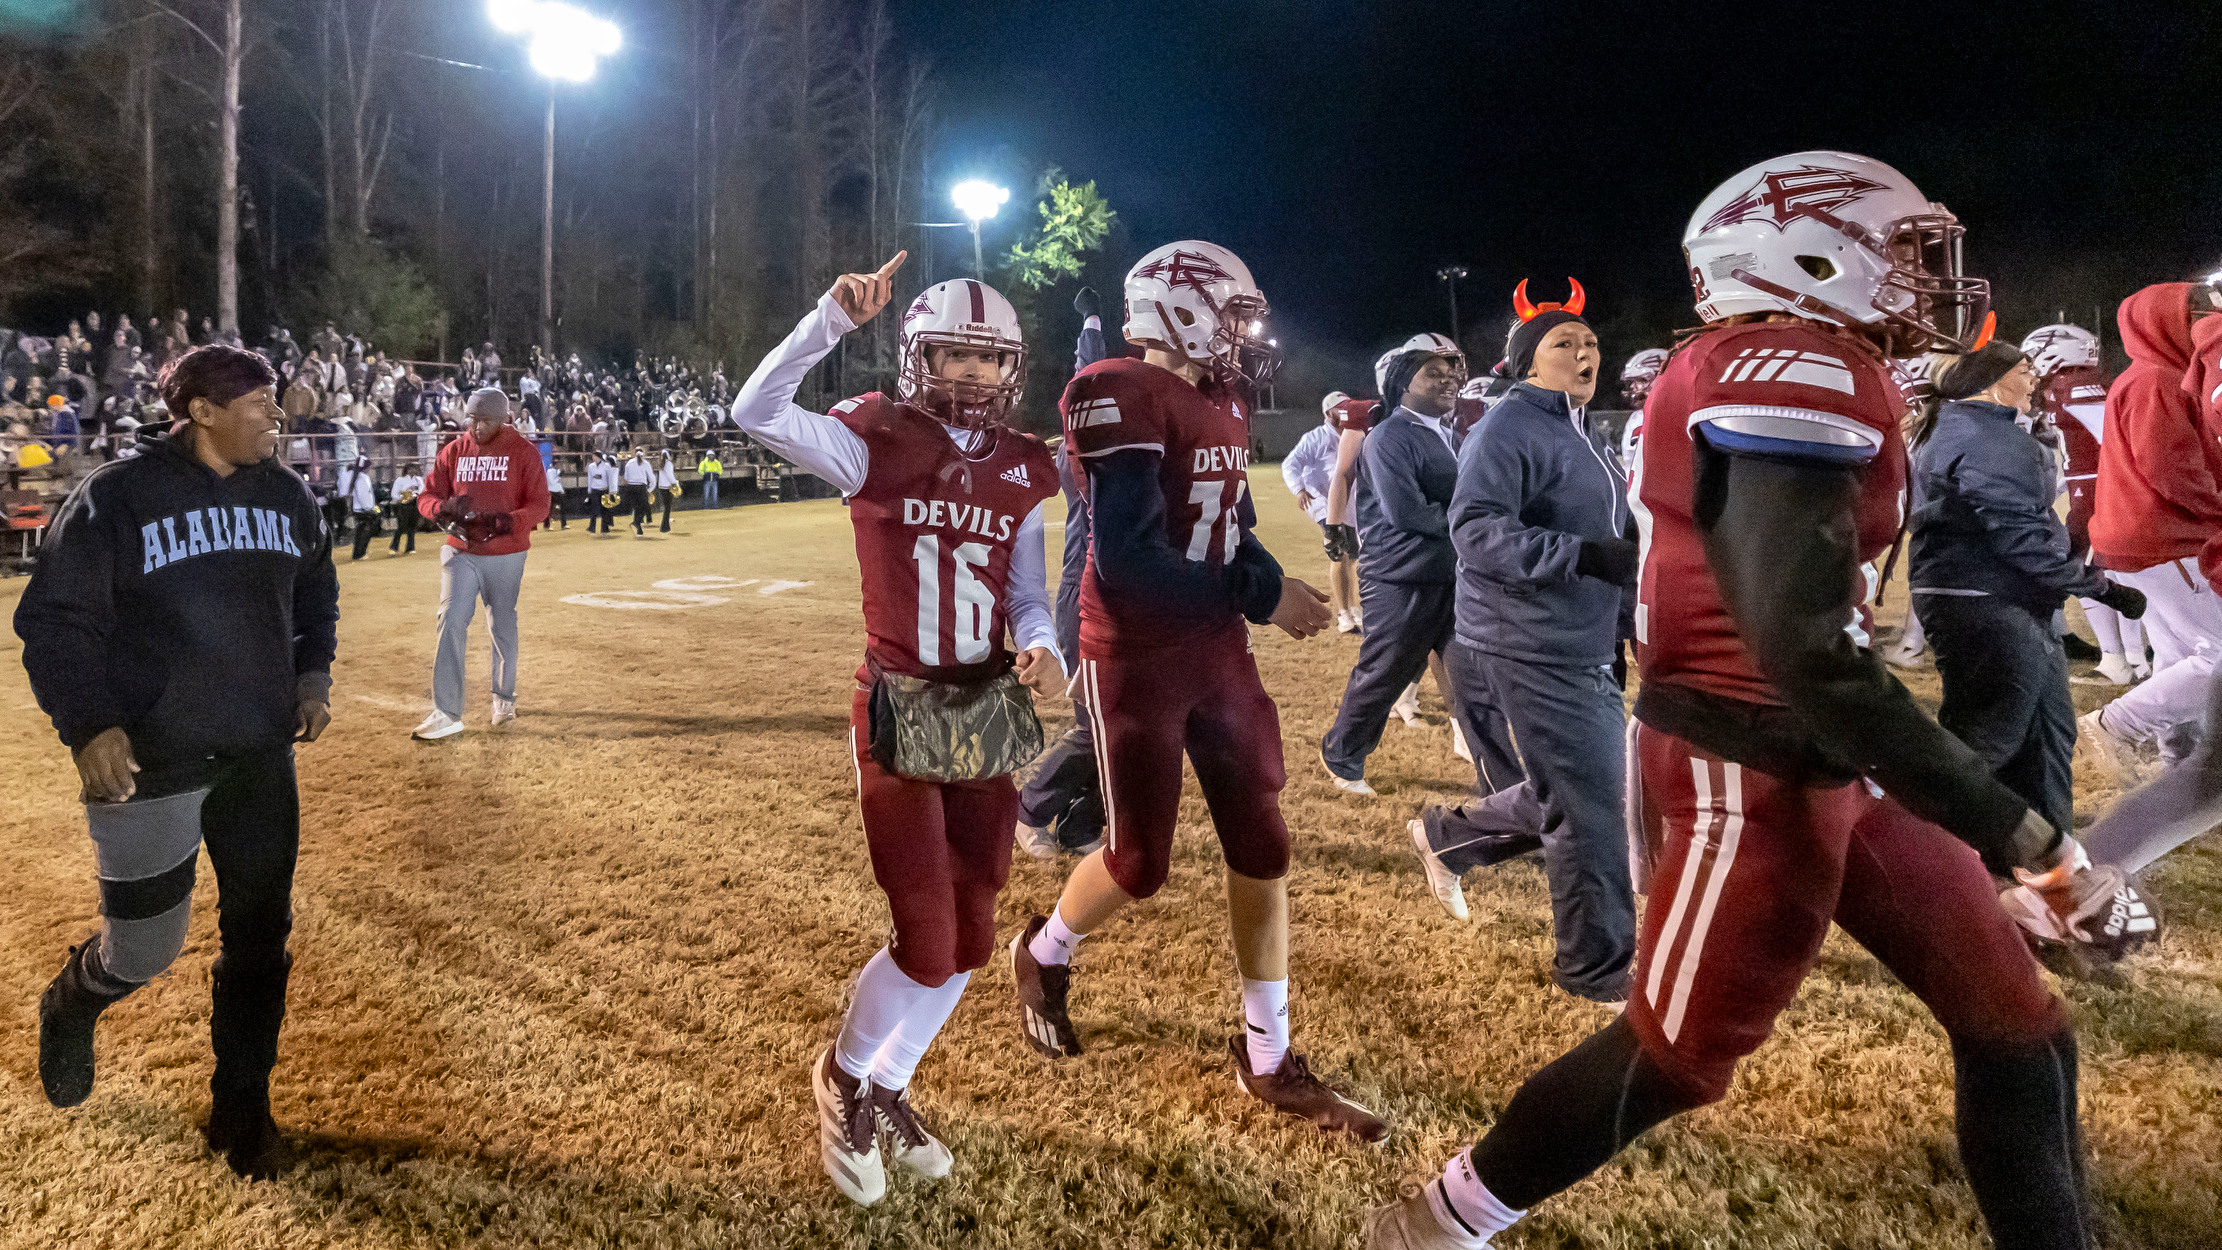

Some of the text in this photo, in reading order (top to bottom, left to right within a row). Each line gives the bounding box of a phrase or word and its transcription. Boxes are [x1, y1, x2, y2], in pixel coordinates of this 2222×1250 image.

[456, 456, 509, 471] MAPESVILLE
[1000, 472, 1031, 488] adidas
[141, 506, 302, 575] ALABAMA
[903, 498, 1014, 541] DEVILS
[912, 534, 995, 665] 16
